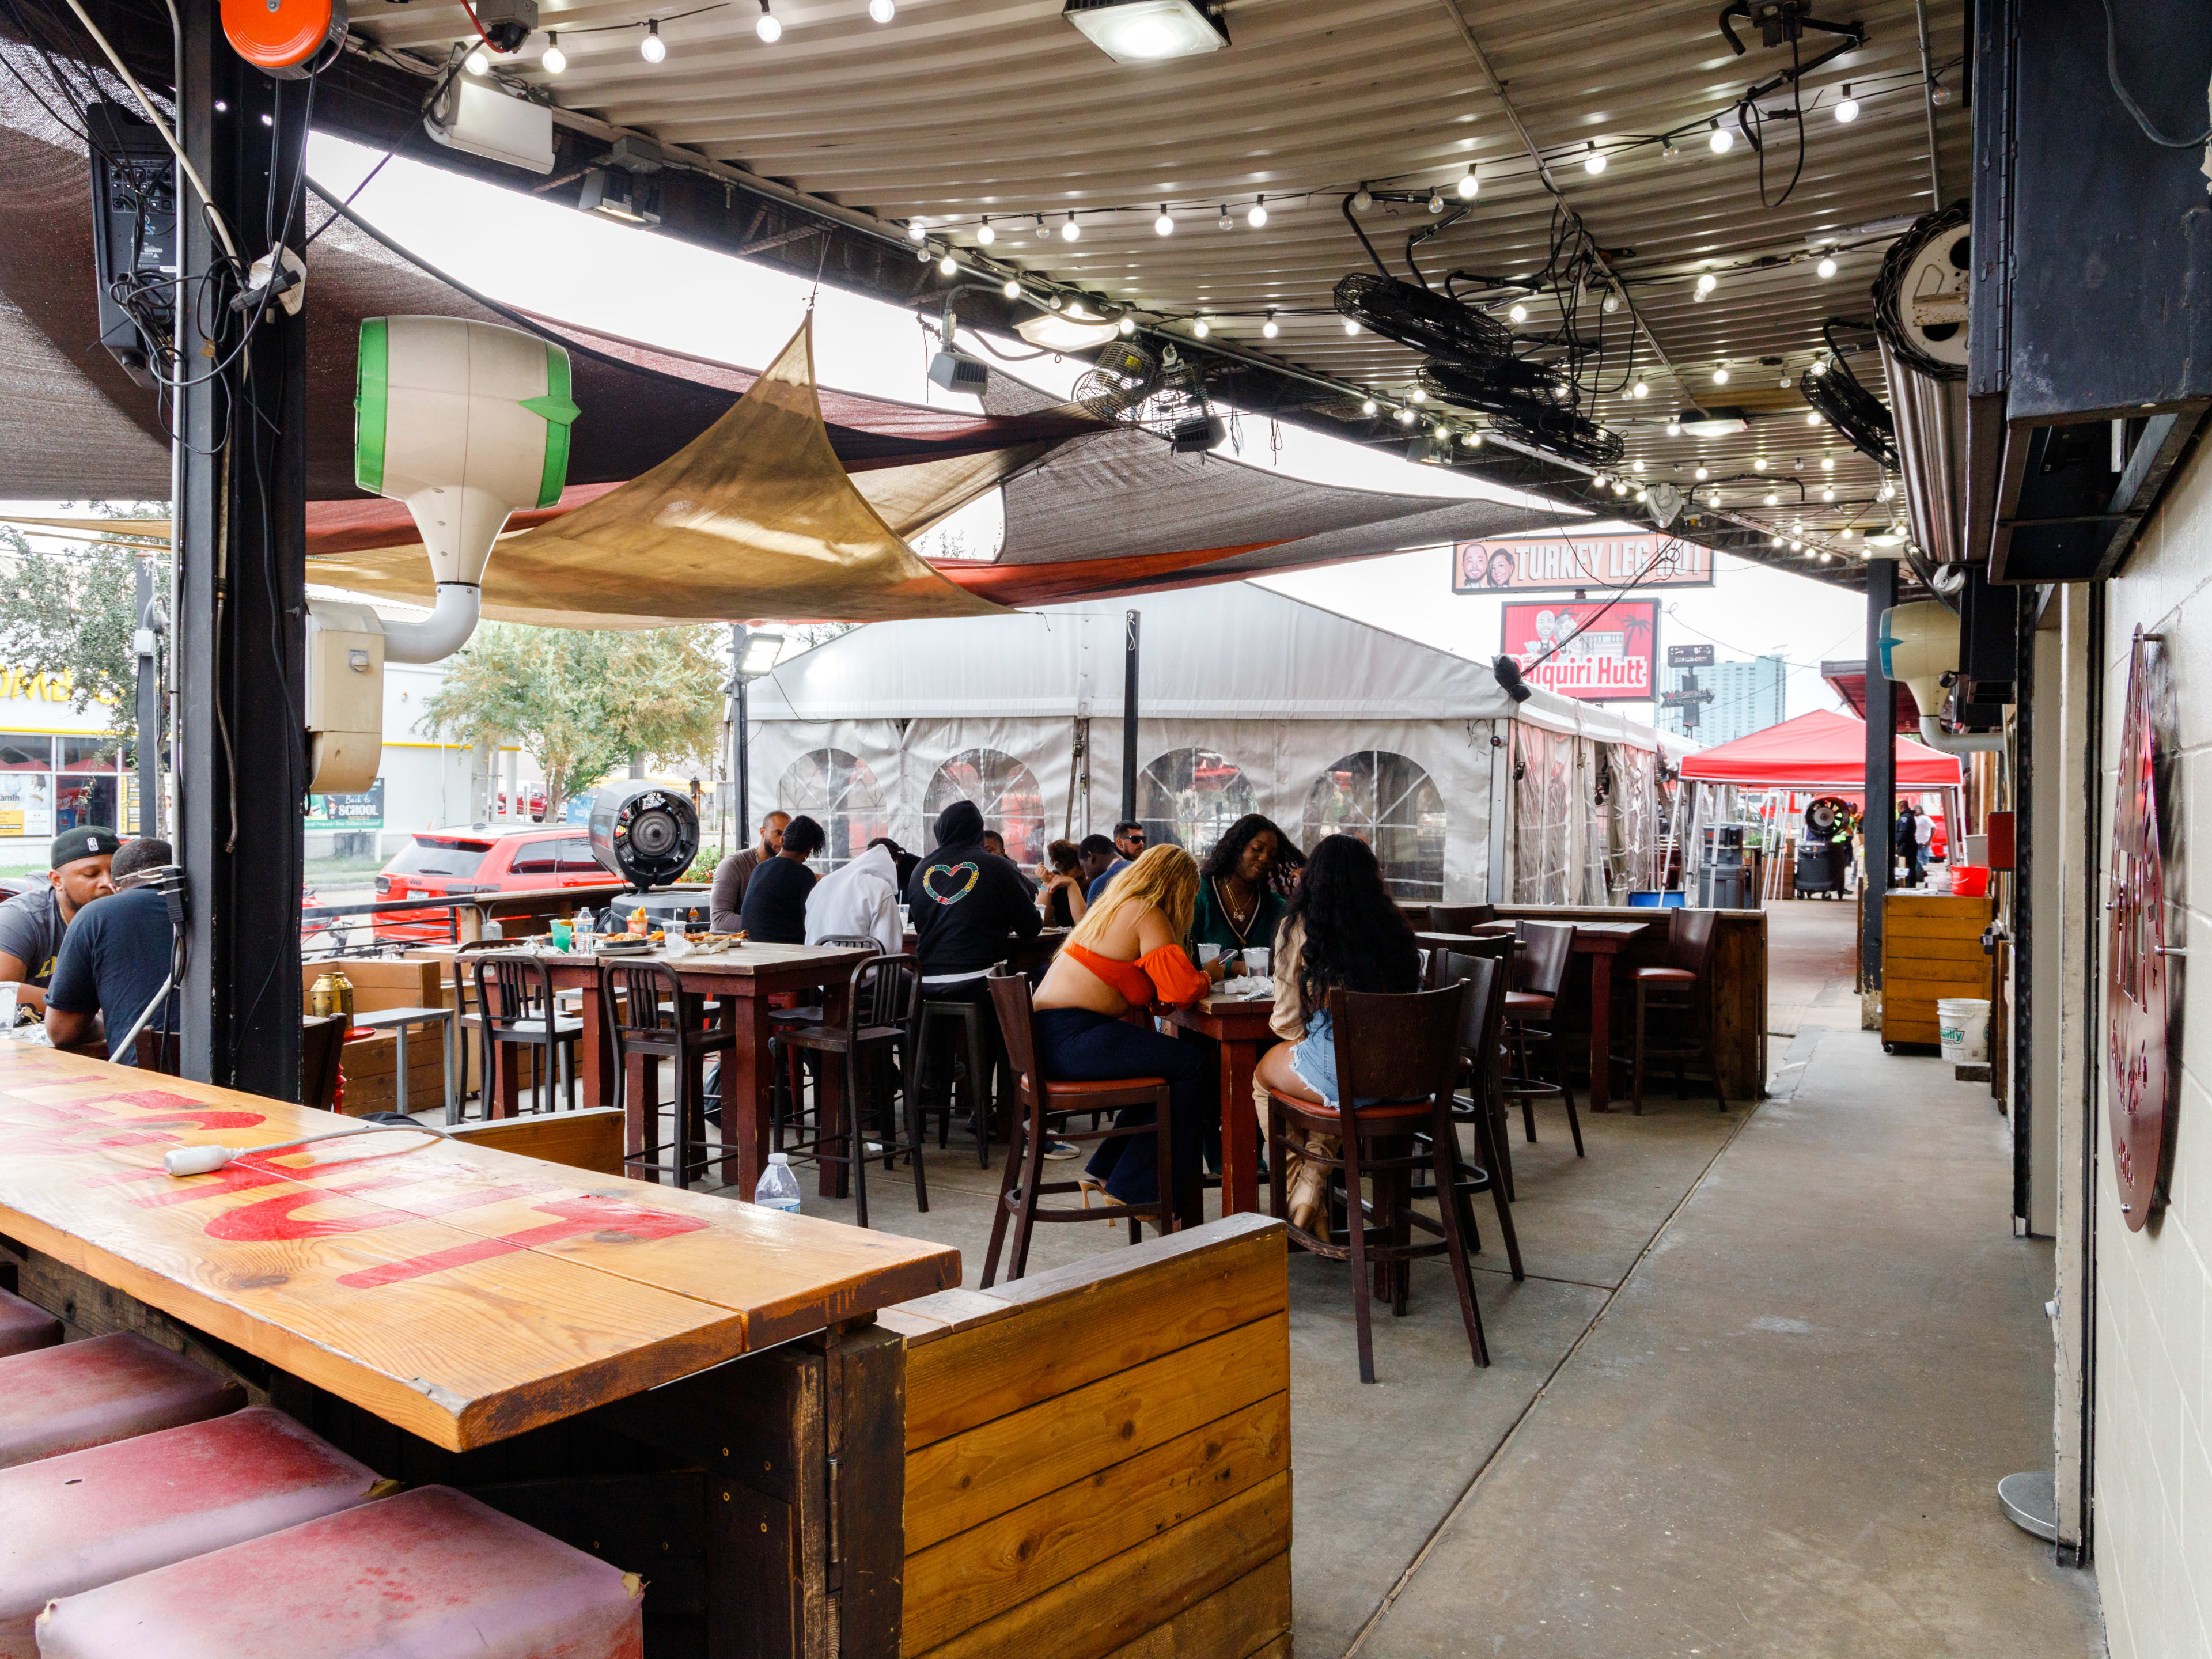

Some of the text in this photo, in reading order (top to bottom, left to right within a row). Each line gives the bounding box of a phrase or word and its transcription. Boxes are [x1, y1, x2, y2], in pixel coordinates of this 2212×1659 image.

[1515, 542, 1604, 581] TURKEY
[1609, 540, 1650, 578] LEG
[1597, 656, 1644, 685] Hutt
[338, 805, 379, 816] SCHOOL
[346, 795, 362, 804] Back
[964, 872, 978, 891] BLACK
[77, 1137, 711, 1289] HUT
